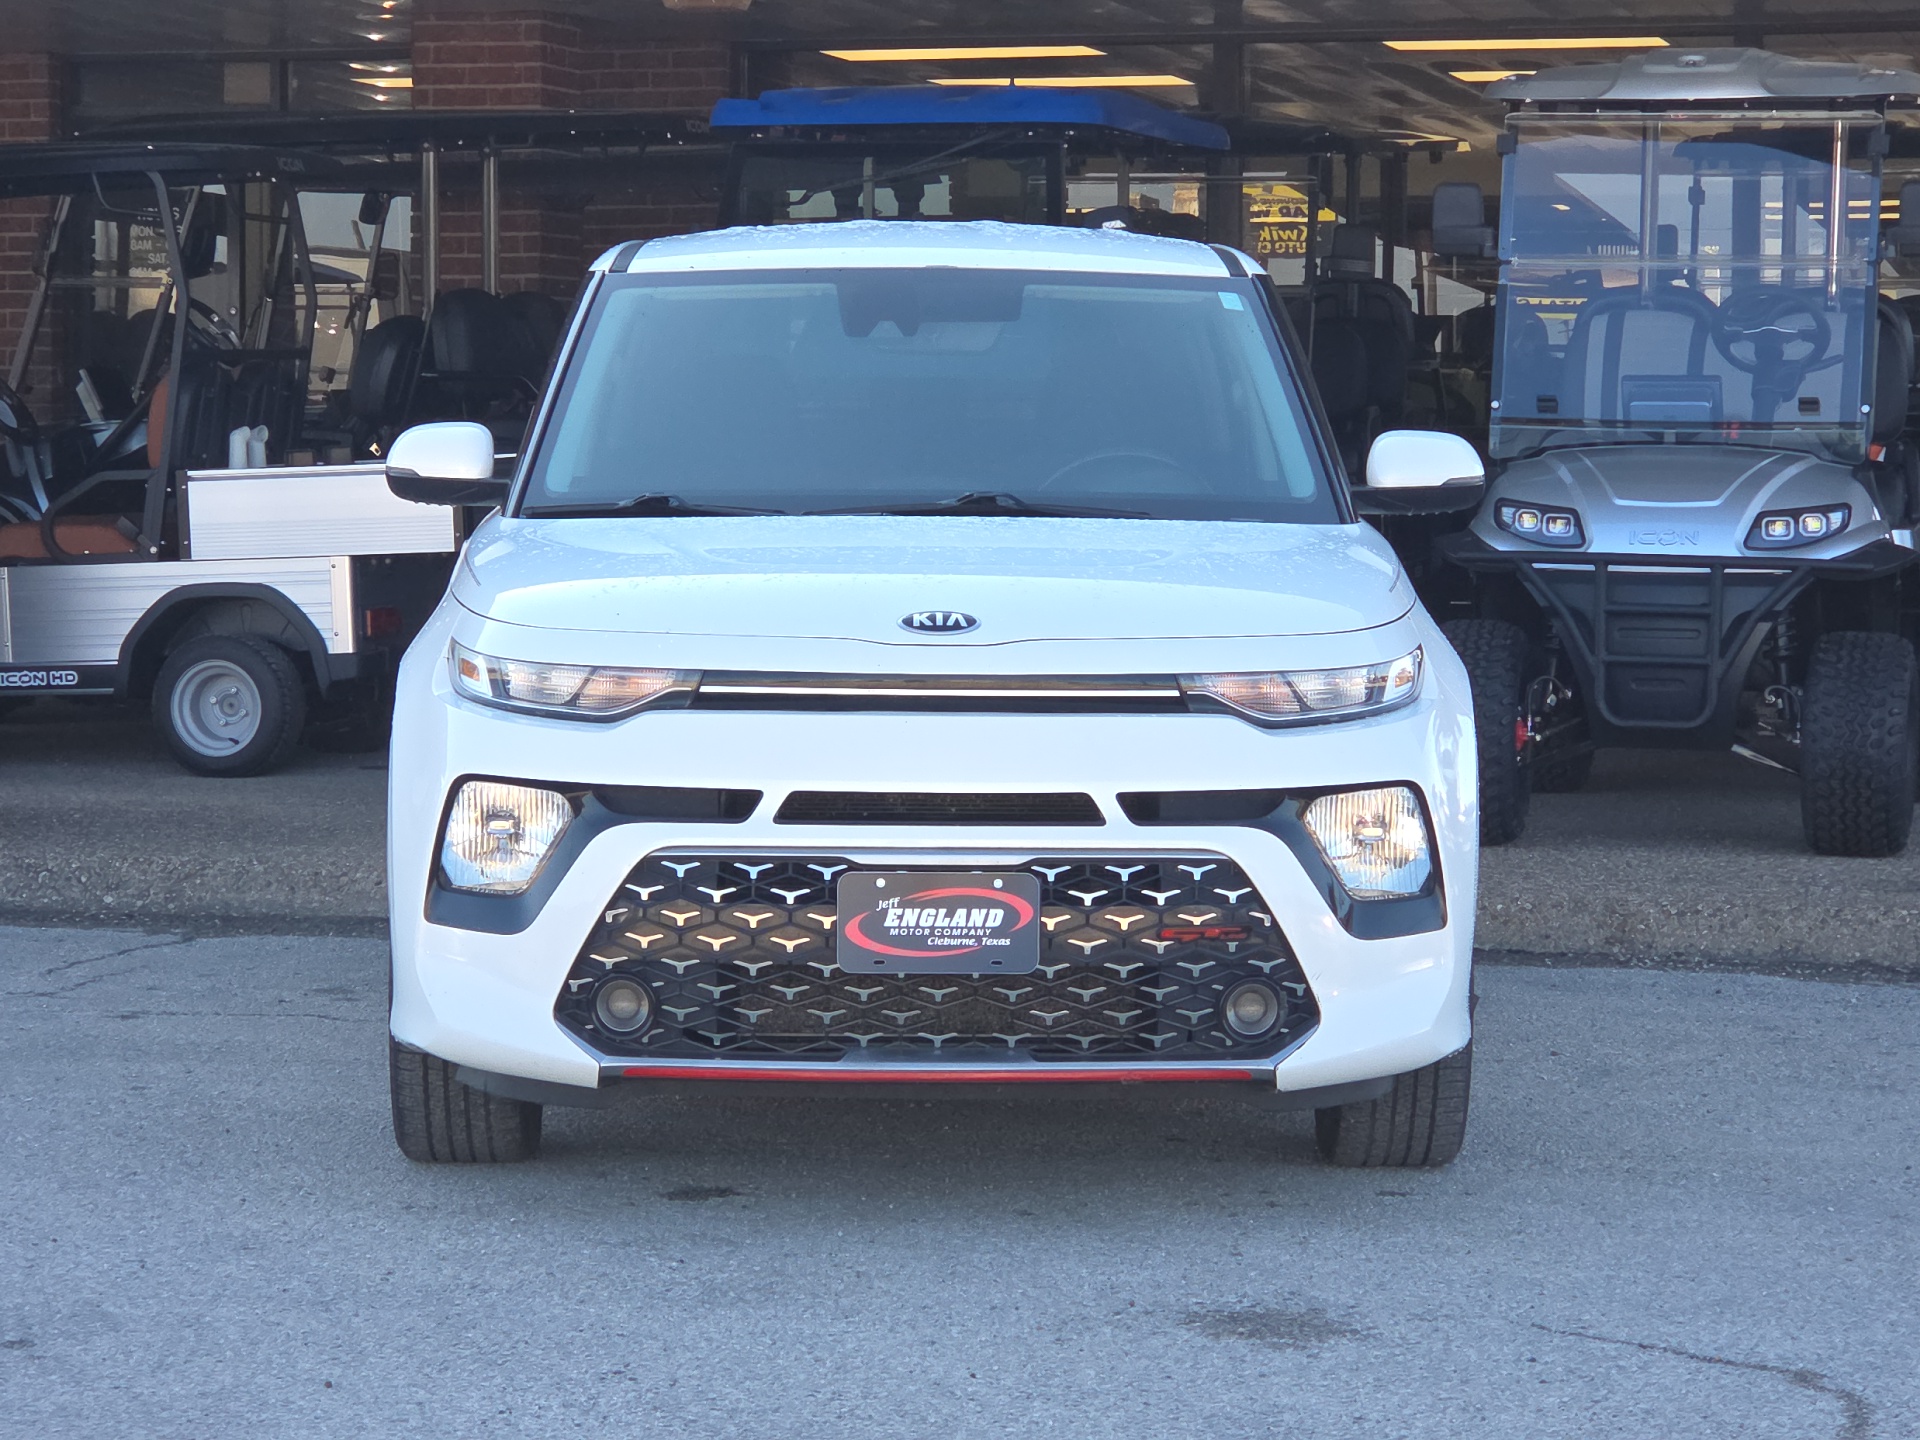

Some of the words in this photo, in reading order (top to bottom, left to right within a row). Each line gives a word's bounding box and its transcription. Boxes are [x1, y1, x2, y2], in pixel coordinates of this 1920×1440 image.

[1628, 529, 1699, 546] ICON
[913, 612, 968, 627] KIA
[0, 670, 47, 687] ICON
[49, 670, 78, 685] HD
[883, 908, 1005, 927] ENGLAND
[889, 928, 930, 936] MOTOR
[934, 928, 992, 936] COMPANY
[927, 937, 979, 947] Cleburne,
[981, 937, 1011, 946] Texas
